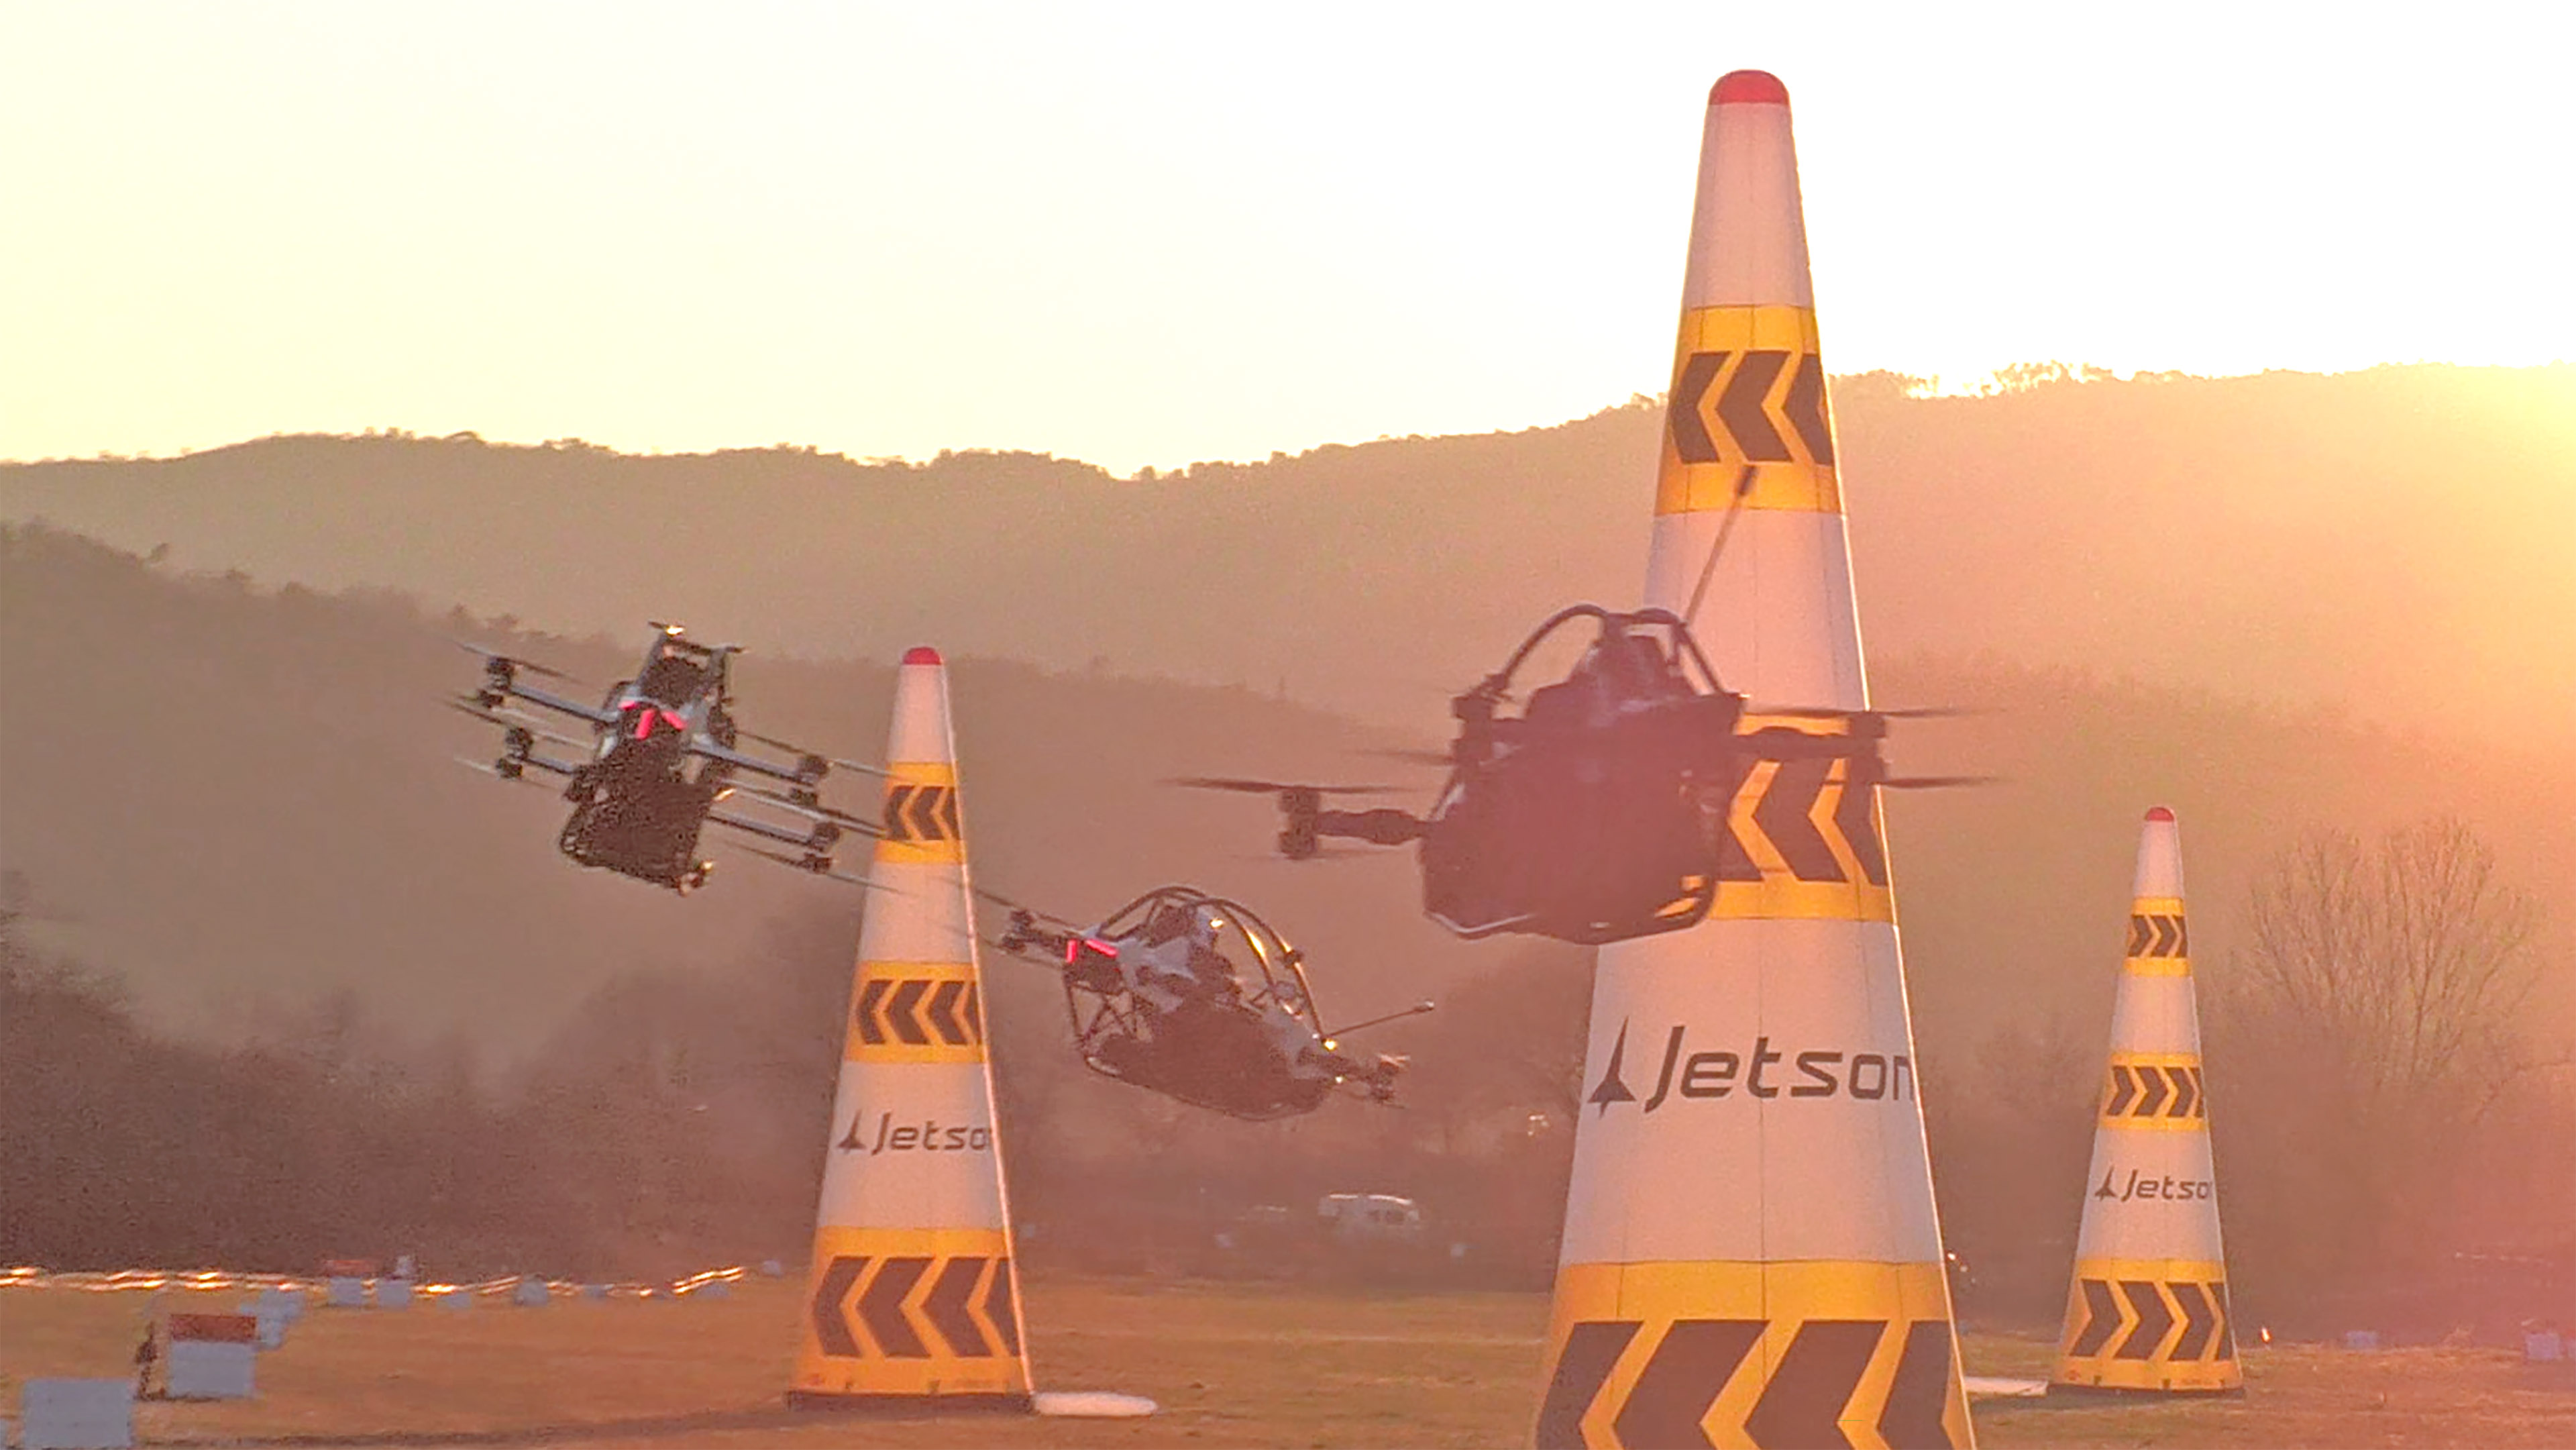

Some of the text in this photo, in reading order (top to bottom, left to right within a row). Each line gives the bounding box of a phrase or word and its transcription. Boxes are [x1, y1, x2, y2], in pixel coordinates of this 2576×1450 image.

[1644, 1025, 1915, 1113] Jetson
[871, 1111, 991, 1155] Jetso
[2121, 1169, 2212, 1202] Jetso
